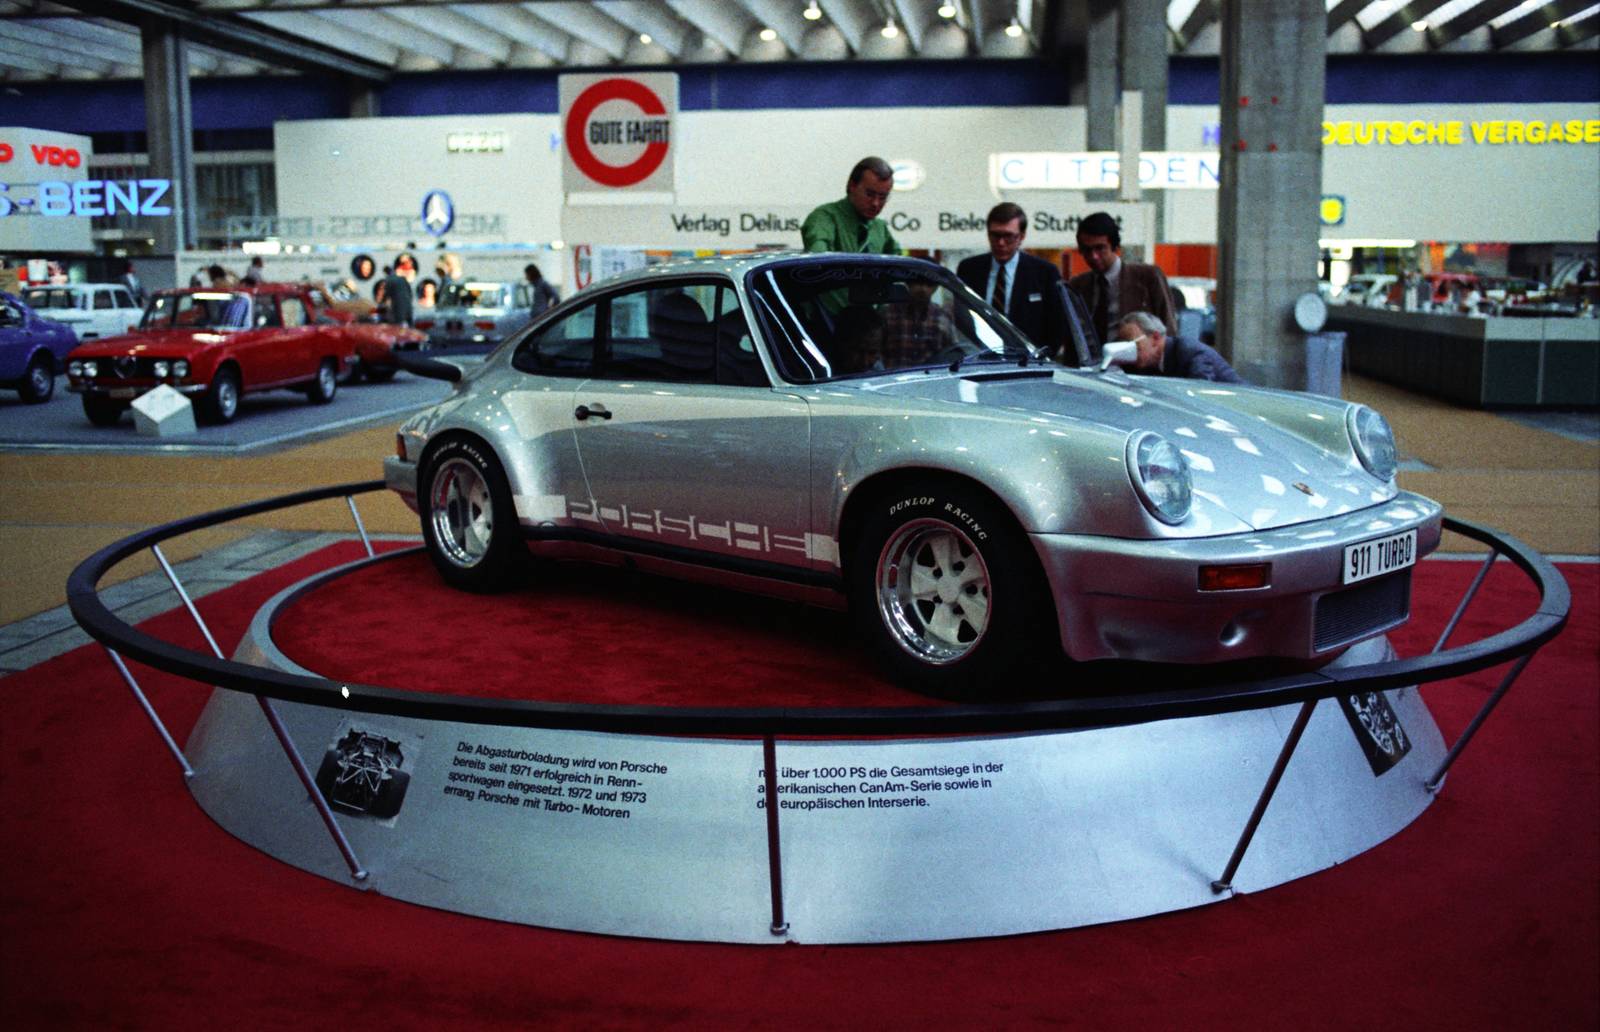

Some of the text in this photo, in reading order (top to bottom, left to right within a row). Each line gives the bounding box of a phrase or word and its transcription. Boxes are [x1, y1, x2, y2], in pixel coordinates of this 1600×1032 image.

[590, 120, 670, 145] GUTE FAHRT
[1321, 119, 1600, 146] DEUTSCHE VERGASE
[31, 144, 81, 168] VDO
[671, 213, 730, 237] Verlag
[891, 212, 921, 231] Co
[938, 212, 988, 231] Biele
[1034, 211, 1122, 231] Stuttt
[889, 496, 988, 540] DUNLOP RACING
[1351, 534, 1412, 578] 911 TURBO
[452, 755, 643, 788] bereits seit 1971 erfolgreich in Renn-
[456, 741, 668, 775] Die Abgasturboladung wird von Porsche
[781, 766, 810, 779] über
[849, 766, 867, 779] PS
[869, 766, 888, 779] die
[890, 763, 970, 780] Gesamtsiege
[972, 762, 984, 775] in
[984, 761, 1005, 774] der
[447, 771, 647, 804] sportwagen eingesetzt. 1972 und 1973
[757, 777, 992, 795] aerikanischen CanAm-Serie sowie in
[443, 785, 631, 819] errang Porsche mit Turbo- Motoren
[780, 796, 865, 812] europäischen
[867, 795, 931, 809] Interserie.
